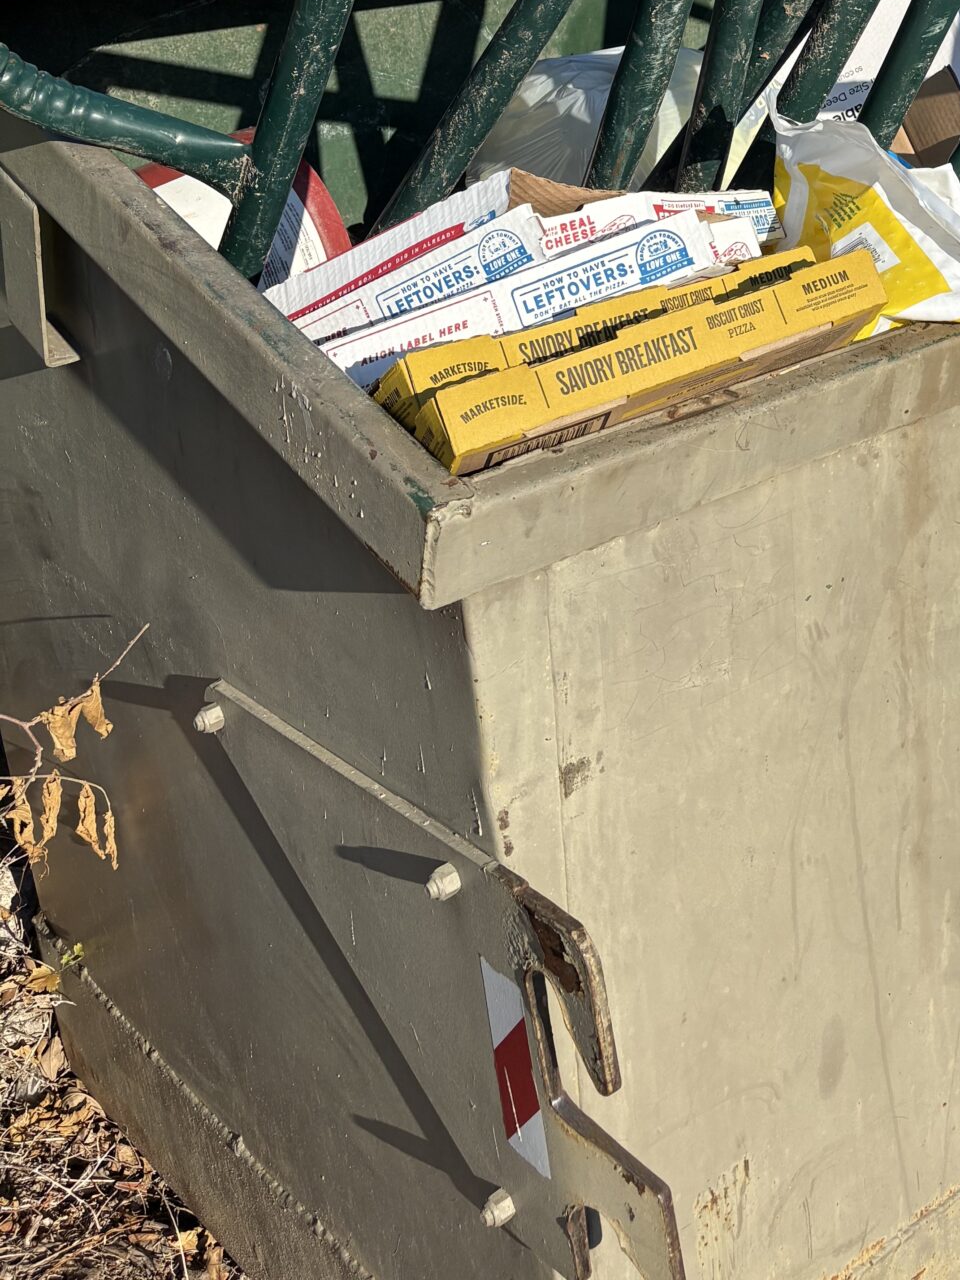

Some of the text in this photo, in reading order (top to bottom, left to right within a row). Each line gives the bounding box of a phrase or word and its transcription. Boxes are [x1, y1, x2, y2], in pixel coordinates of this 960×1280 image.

[849, 81, 870, 95] Size
[545, 226, 597, 250] CHEESE
[560, 215, 595, 234] REAL
[422, 230, 456, 250] ALREADY
[490, 249, 520, 271] LOVE ONE
[646, 251, 681, 271] LOVE ONE
[400, 264, 453, 294] HOW TO HAVE
[522, 263, 635, 314] LEFTOVERS:
[543, 261, 606, 290] HOW TO HAVE
[750, 265, 793, 287] MEDIUM
[802, 270, 850, 296] MEDIUM
[387, 264, 481, 318] LEFTOVERS:
[534, 280, 628, 319] DON'T EAT ALL THE PIZZA.
[660, 286, 715, 313] BISCUIT CRUST
[706, 298, 766, 330] BISCUIT CRUST
[361, 320, 469, 366] ALIGN LABEL HERE
[727, 322, 757, 339] PIZZA
[518, 328, 574, 365] SAVORY
[555, 354, 616, 396] SAVORY
[615, 326, 698, 376] BREAKFAST
